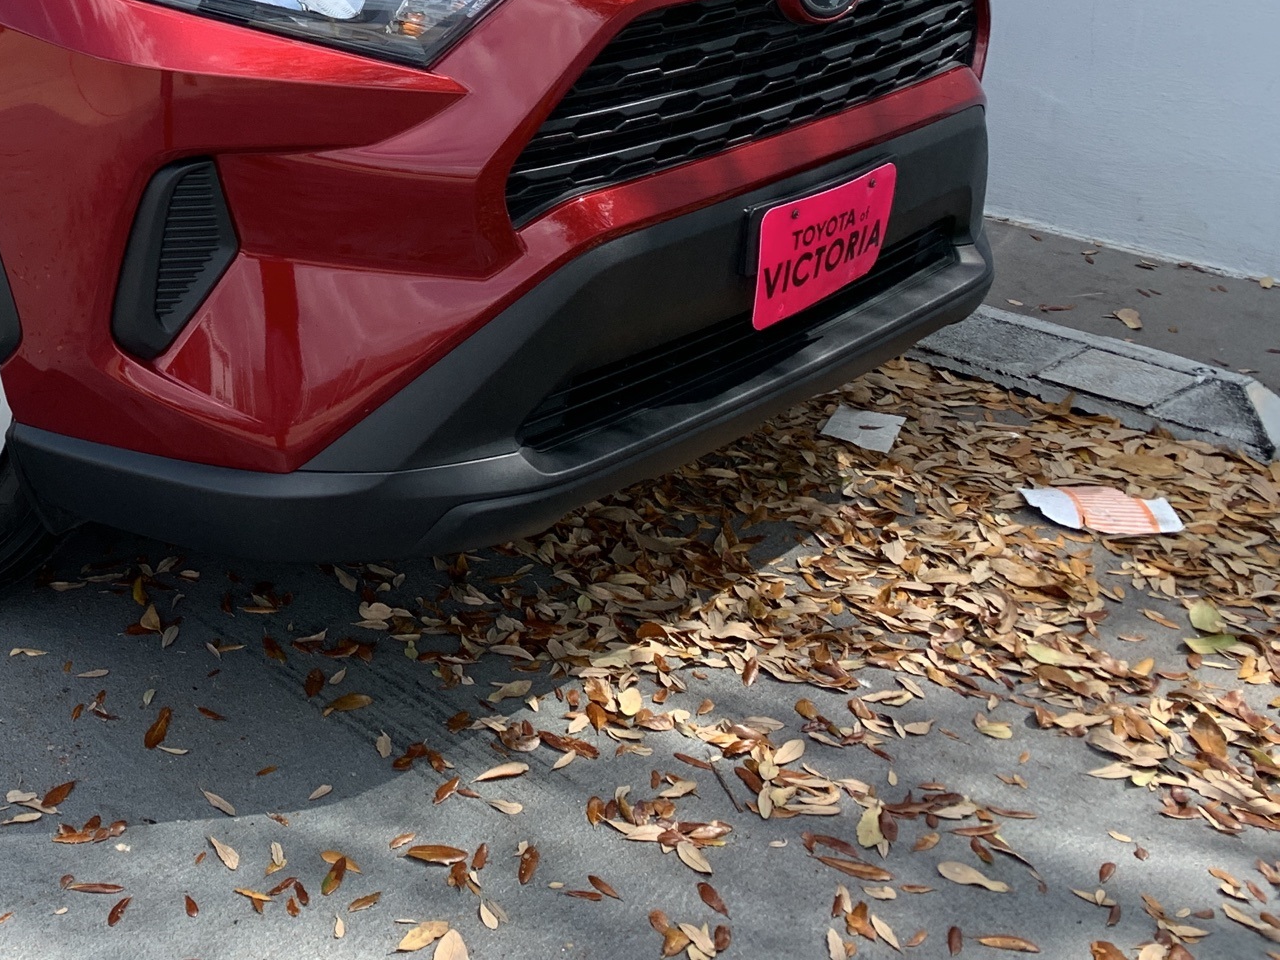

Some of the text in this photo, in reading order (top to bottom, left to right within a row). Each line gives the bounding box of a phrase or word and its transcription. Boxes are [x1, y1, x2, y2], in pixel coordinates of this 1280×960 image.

[792, 205, 870, 250] TOYOTA of
[763, 219, 881, 299] VICTORIA
